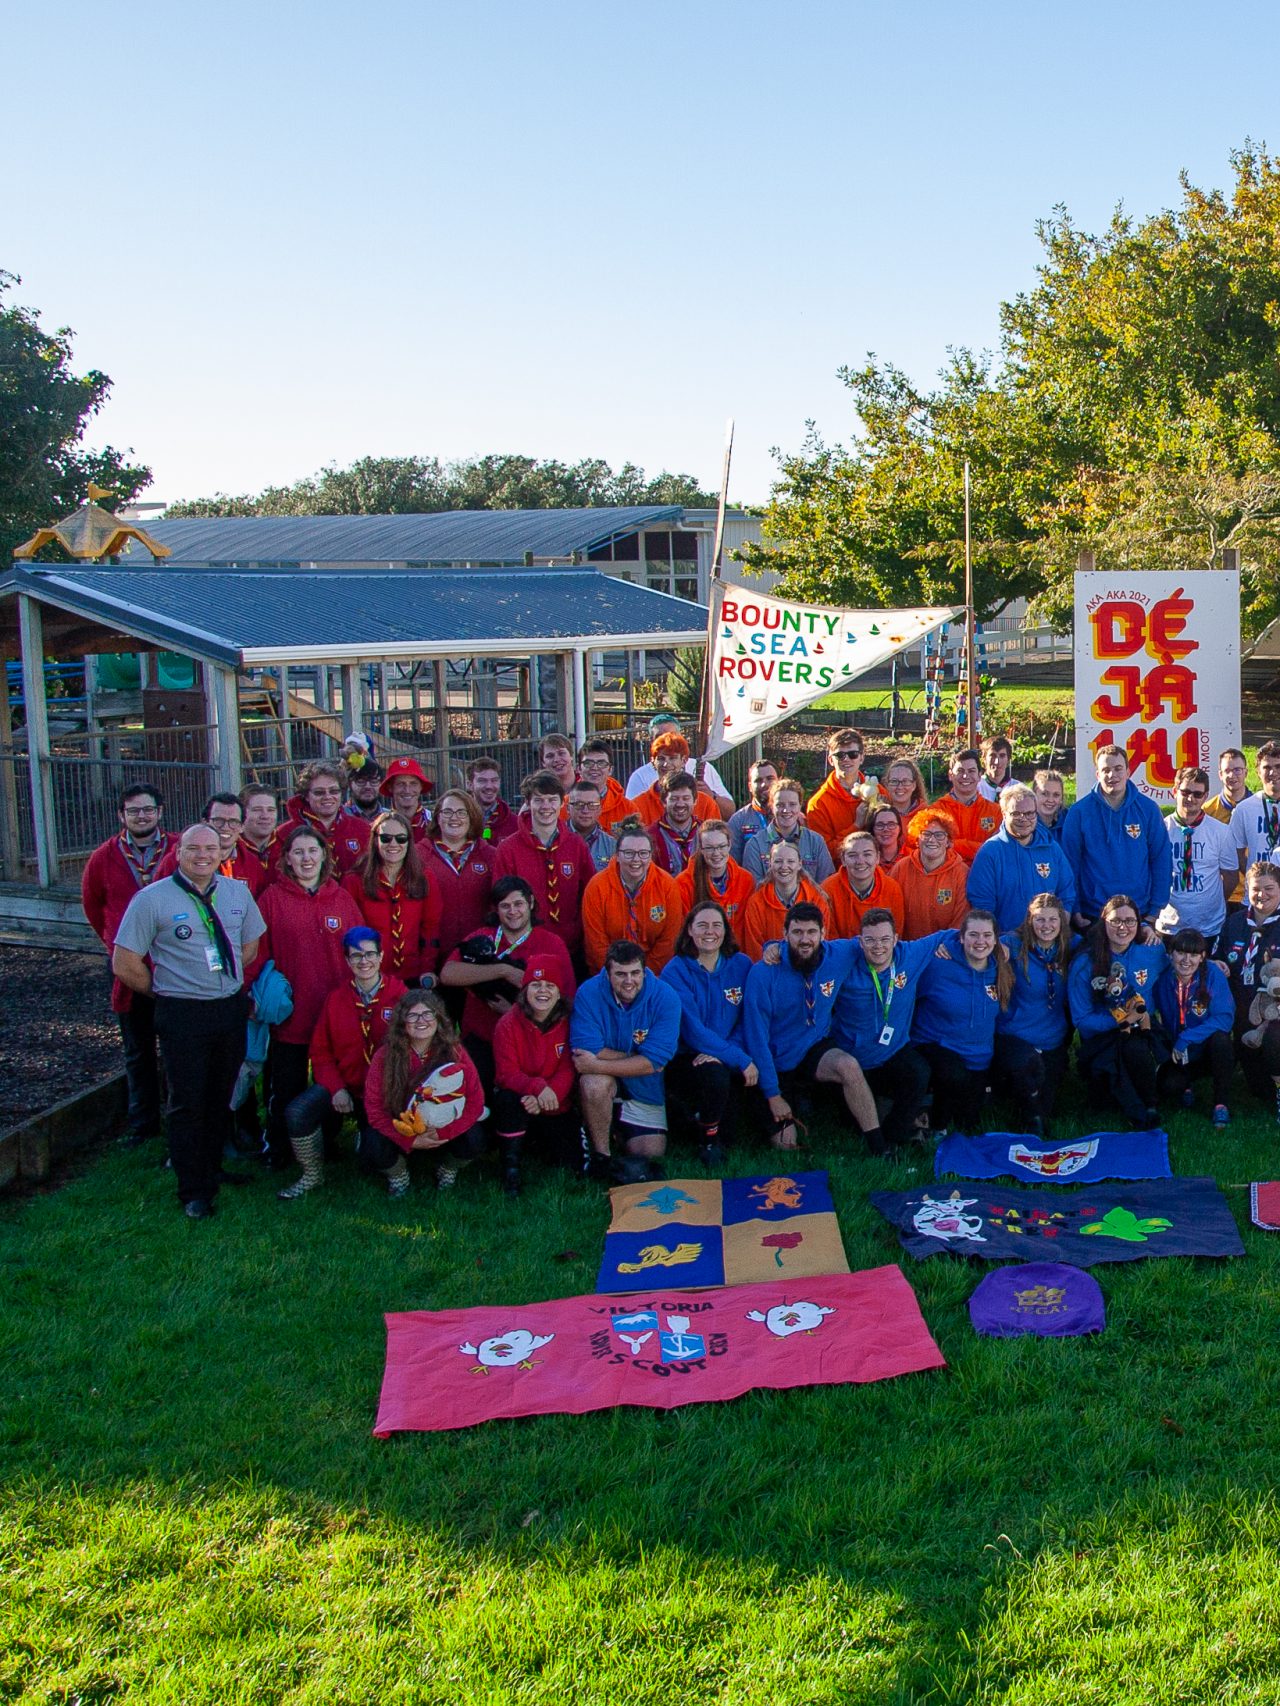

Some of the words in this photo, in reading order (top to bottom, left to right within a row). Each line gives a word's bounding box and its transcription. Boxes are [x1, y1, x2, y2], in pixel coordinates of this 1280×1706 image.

[1085, 594, 1104, 613] AKA
[1106, 590, 1127, 600] AKA
[1129, 590, 1151, 606] 2021
[721, 600, 841, 636] BOUNTY
[750, 632, 809, 657] SEA
[718, 656, 835, 688] ROVERS
[1200, 729, 1210, 762] MOOT
[1136, 779, 1165, 799] 79TH
[588, 1301, 714, 1315] VICTORIA
[607, 1352, 708, 1378] SCOUT
